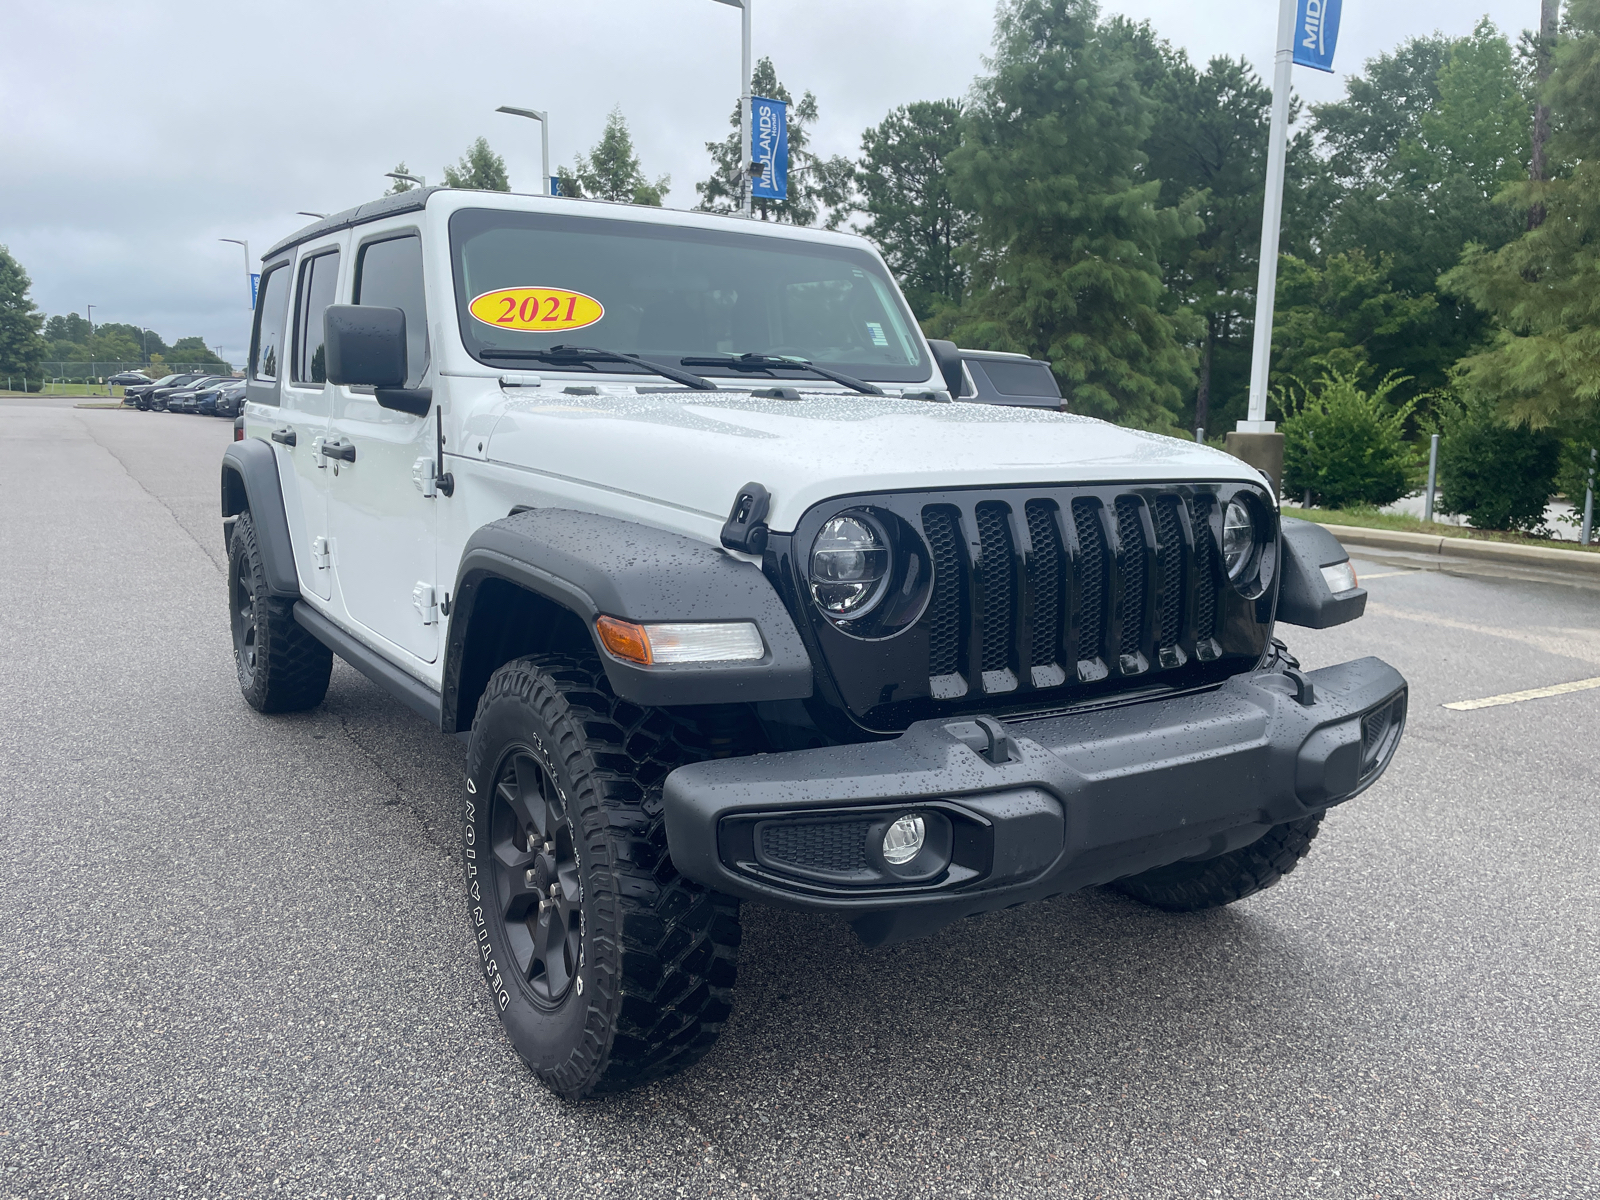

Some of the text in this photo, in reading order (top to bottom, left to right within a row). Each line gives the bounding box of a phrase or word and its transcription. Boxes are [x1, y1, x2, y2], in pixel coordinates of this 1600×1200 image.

[760, 105, 771, 188] MIDLANDS
[496, 296, 577, 323] 2021
[465, 801, 510, 1011] DESTINATION
